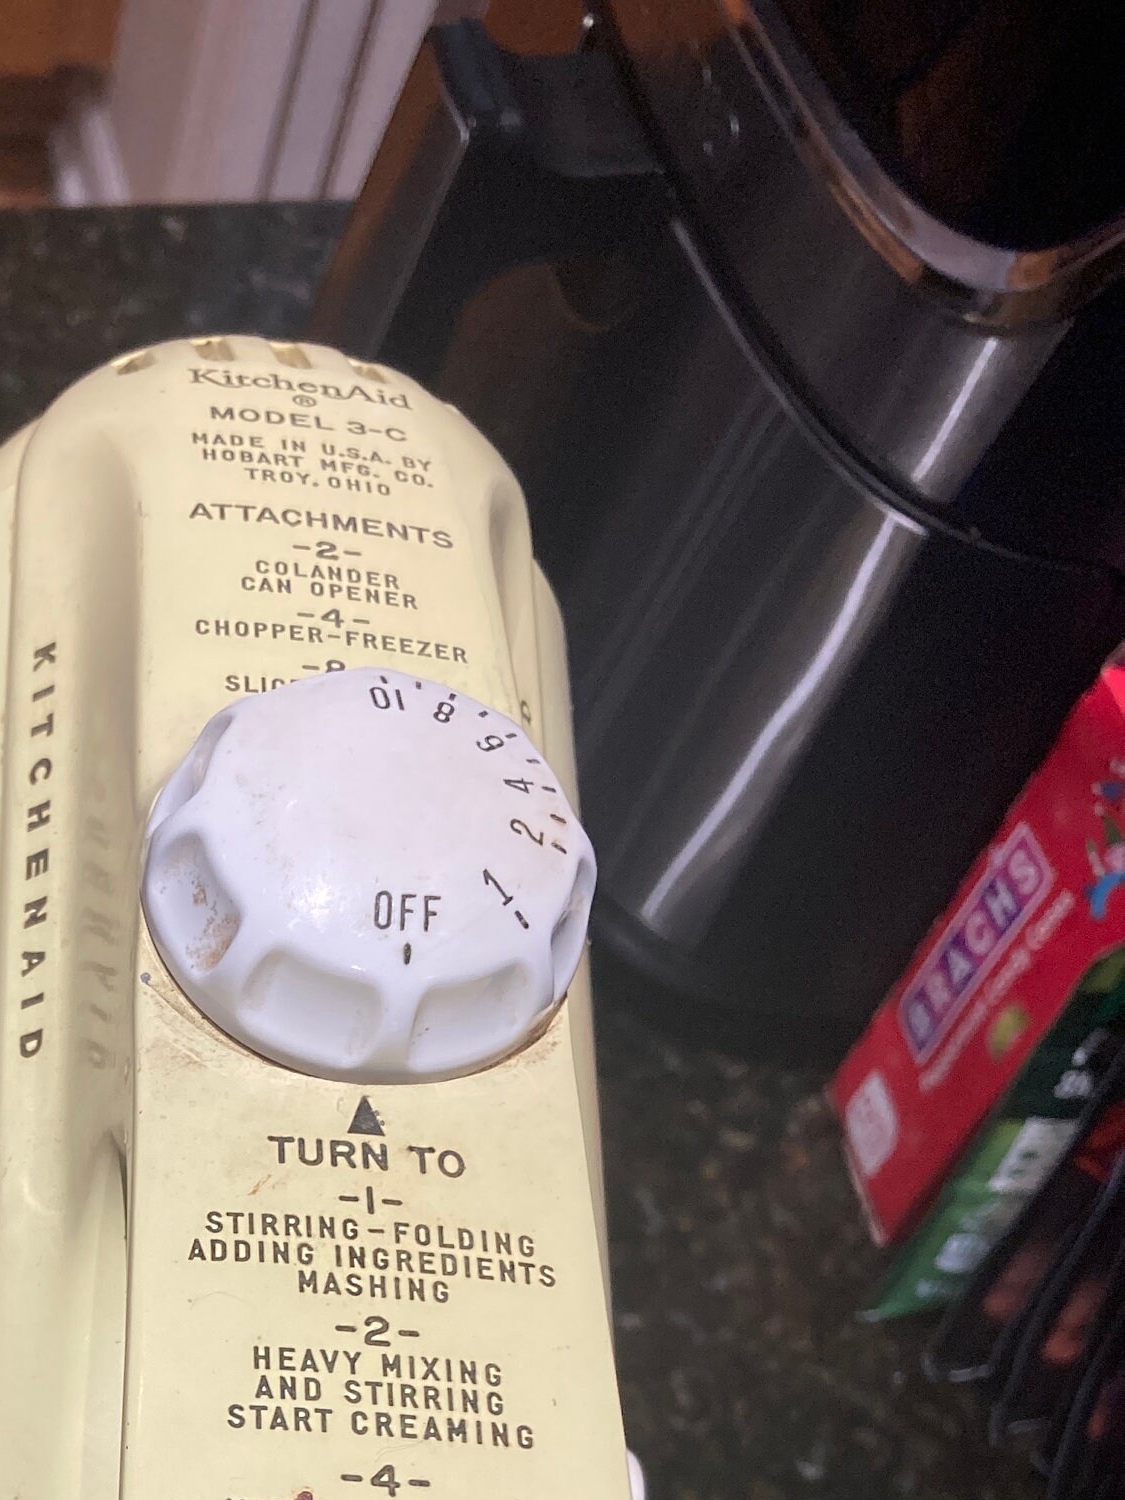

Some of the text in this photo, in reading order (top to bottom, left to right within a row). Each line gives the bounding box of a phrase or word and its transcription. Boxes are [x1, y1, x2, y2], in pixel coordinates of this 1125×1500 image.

[187, 368, 413, 410] KitchenAid
[210, 406, 408, 442] MODEL 3-C
[192, 432, 264, 448] MADE
[281, 440, 306, 453] IN
[402, 456, 433, 472] BY
[203, 448, 304, 467] HOBART
[394, 471, 434, 488] CO.
[328, 476, 391, 496] OHIO
[188, 502, 454, 549] ATTACHMENTS
[241, 576, 418, 610] CAN OPENER
[255, 559, 399, 590] COLANDER
[432, 701, 455, 723] 8
[502, 777, 534, 794] 4
[19, 641, 58, 1059] KITCHENAID
[510, 818, 545, 846] 2
[482, 869, 515, 906] 1
[373, 890, 442, 932] OFF
[267, 1135, 466, 1178] TURN TO
[188, 1239, 557, 1287] ADDING INGREDIENTS
[298, 1271, 450, 1303] MASHING
[253, 1346, 502, 1386] HEAVY MIXING
[255, 1375, 504, 1416] AND STIRRING
[227, 1405, 535, 1449] START CREAMING
